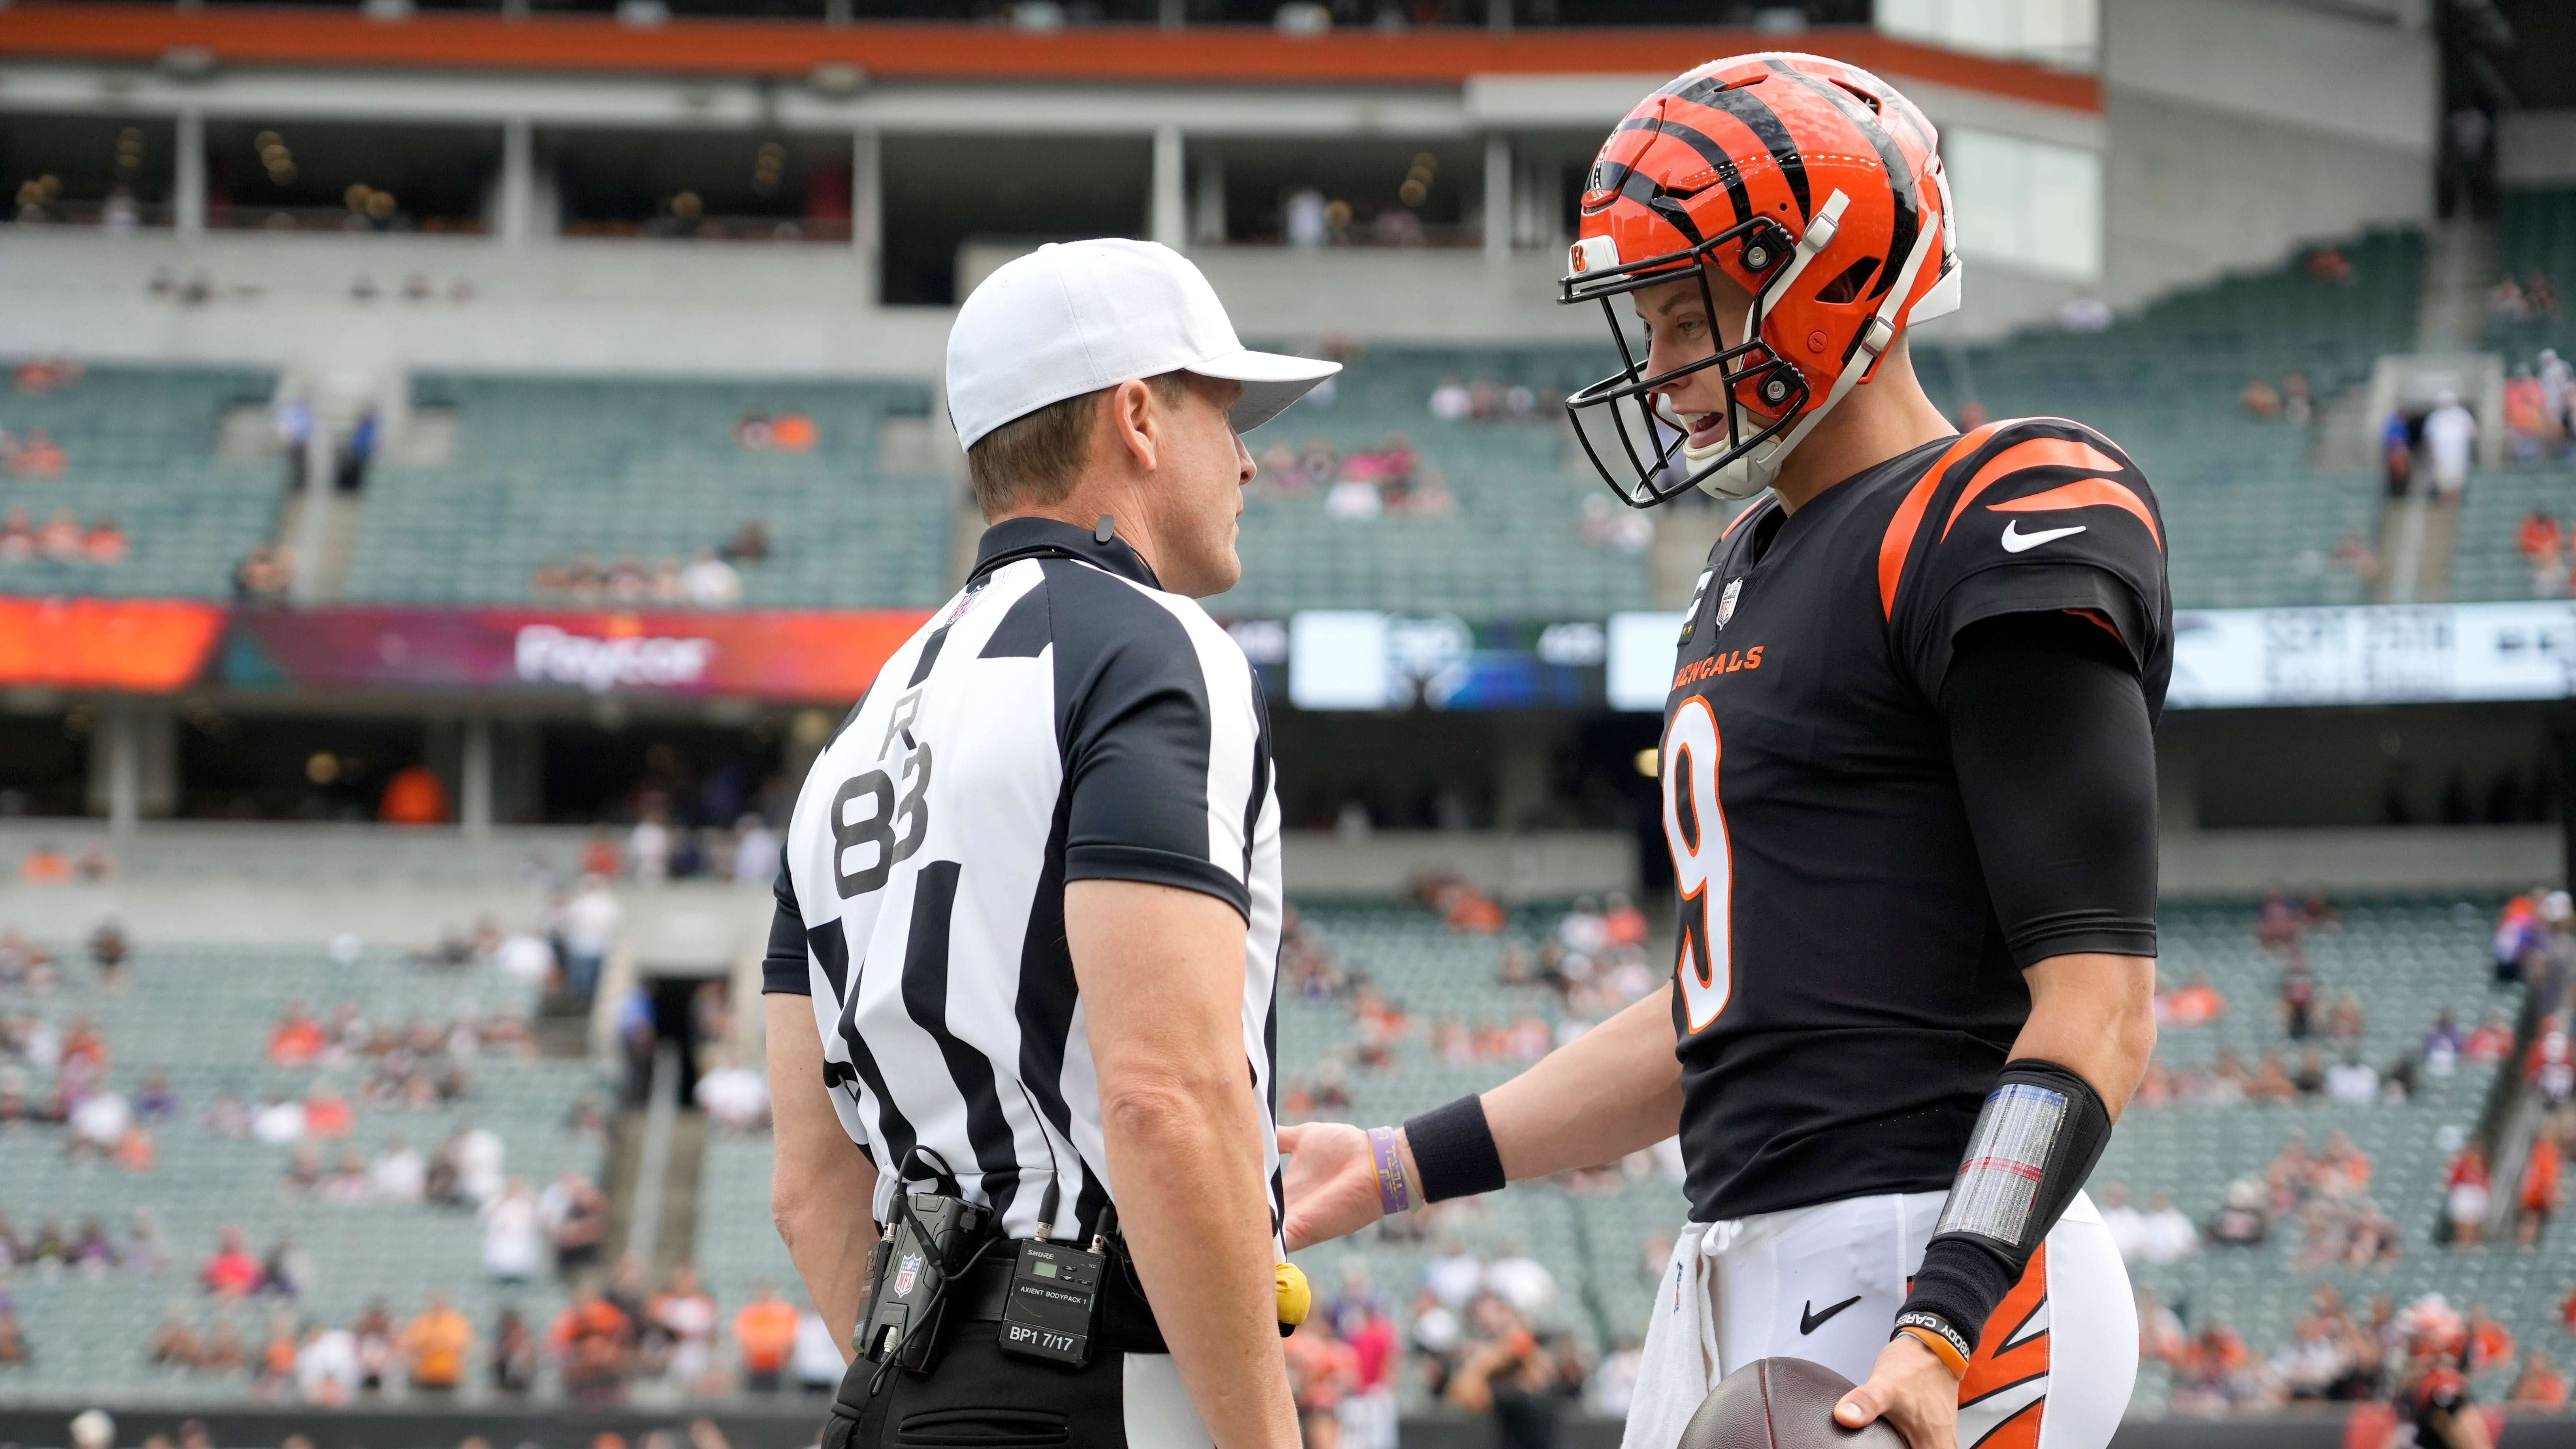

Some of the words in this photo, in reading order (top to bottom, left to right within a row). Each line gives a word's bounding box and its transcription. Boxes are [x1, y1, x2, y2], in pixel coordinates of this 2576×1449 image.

[1672, 646, 1764, 691] BENGALS
[877, 687, 923, 762] R
[831, 741, 932, 900] 83
[1662, 694, 1732, 1034] 9
[1027, 1249, 1054, 1260] SHURE
[897, 1272, 912, 1291] NFL
[1020, 1286, 1044, 1296] AXIENT
[1046, 1291, 1082, 1304] BODYPACK
[1009, 1326, 1038, 1344] BP1
[1042, 1333, 1074, 1351] 7/17
[1941, 1324, 1971, 1363] OBODY
